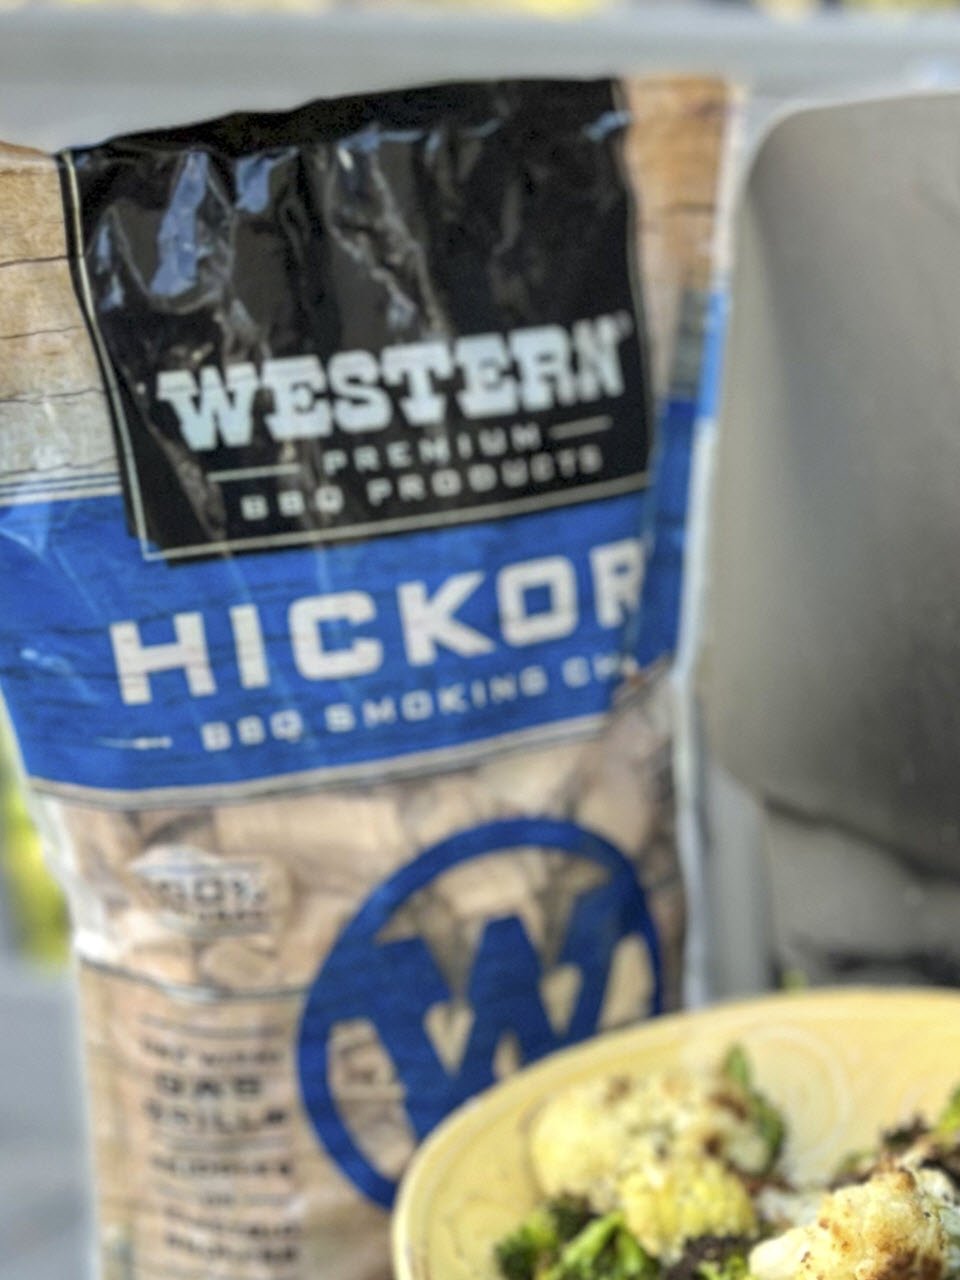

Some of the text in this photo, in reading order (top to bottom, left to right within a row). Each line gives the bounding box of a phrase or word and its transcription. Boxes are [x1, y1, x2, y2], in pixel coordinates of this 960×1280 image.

[157, 313, 626, 452] WESTERN
[240, 443, 603, 521] BBQ PRODUCTS
[323, 423, 542, 474] PREMIUM
[201, 709, 303, 751] BBQ
[325, 664, 549, 732] SMOKING
